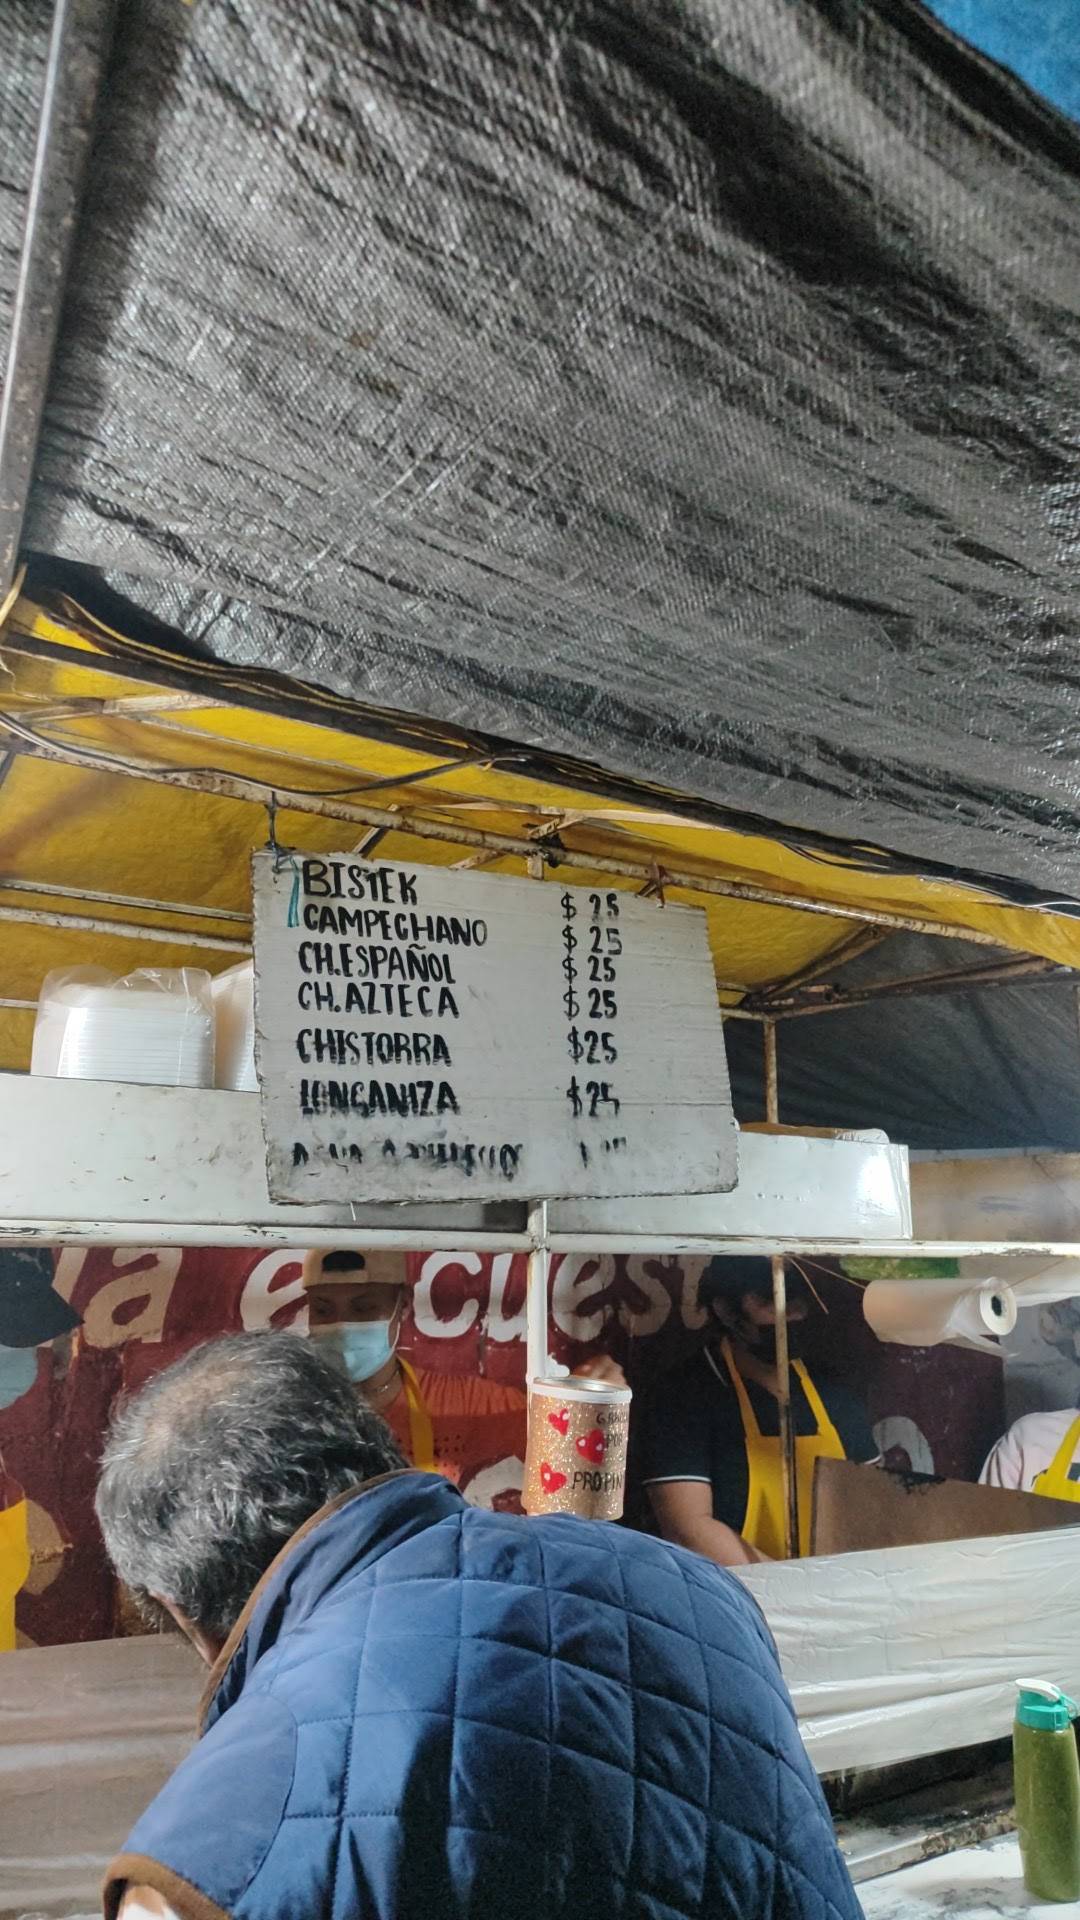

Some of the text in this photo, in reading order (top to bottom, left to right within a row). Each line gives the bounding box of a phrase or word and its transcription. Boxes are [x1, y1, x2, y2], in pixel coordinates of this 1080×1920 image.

[302, 860, 417, 906] BISTEK
[303, 903, 488, 946] CAMPECHANO
[589, 926, 622, 955] 25
[588, 955, 616, 982] 25
[588, 987, 617, 1019] 25
[296, 1028, 452, 1067] CHISTORRA
[300, 1079, 461, 1118] LONGANIZA
